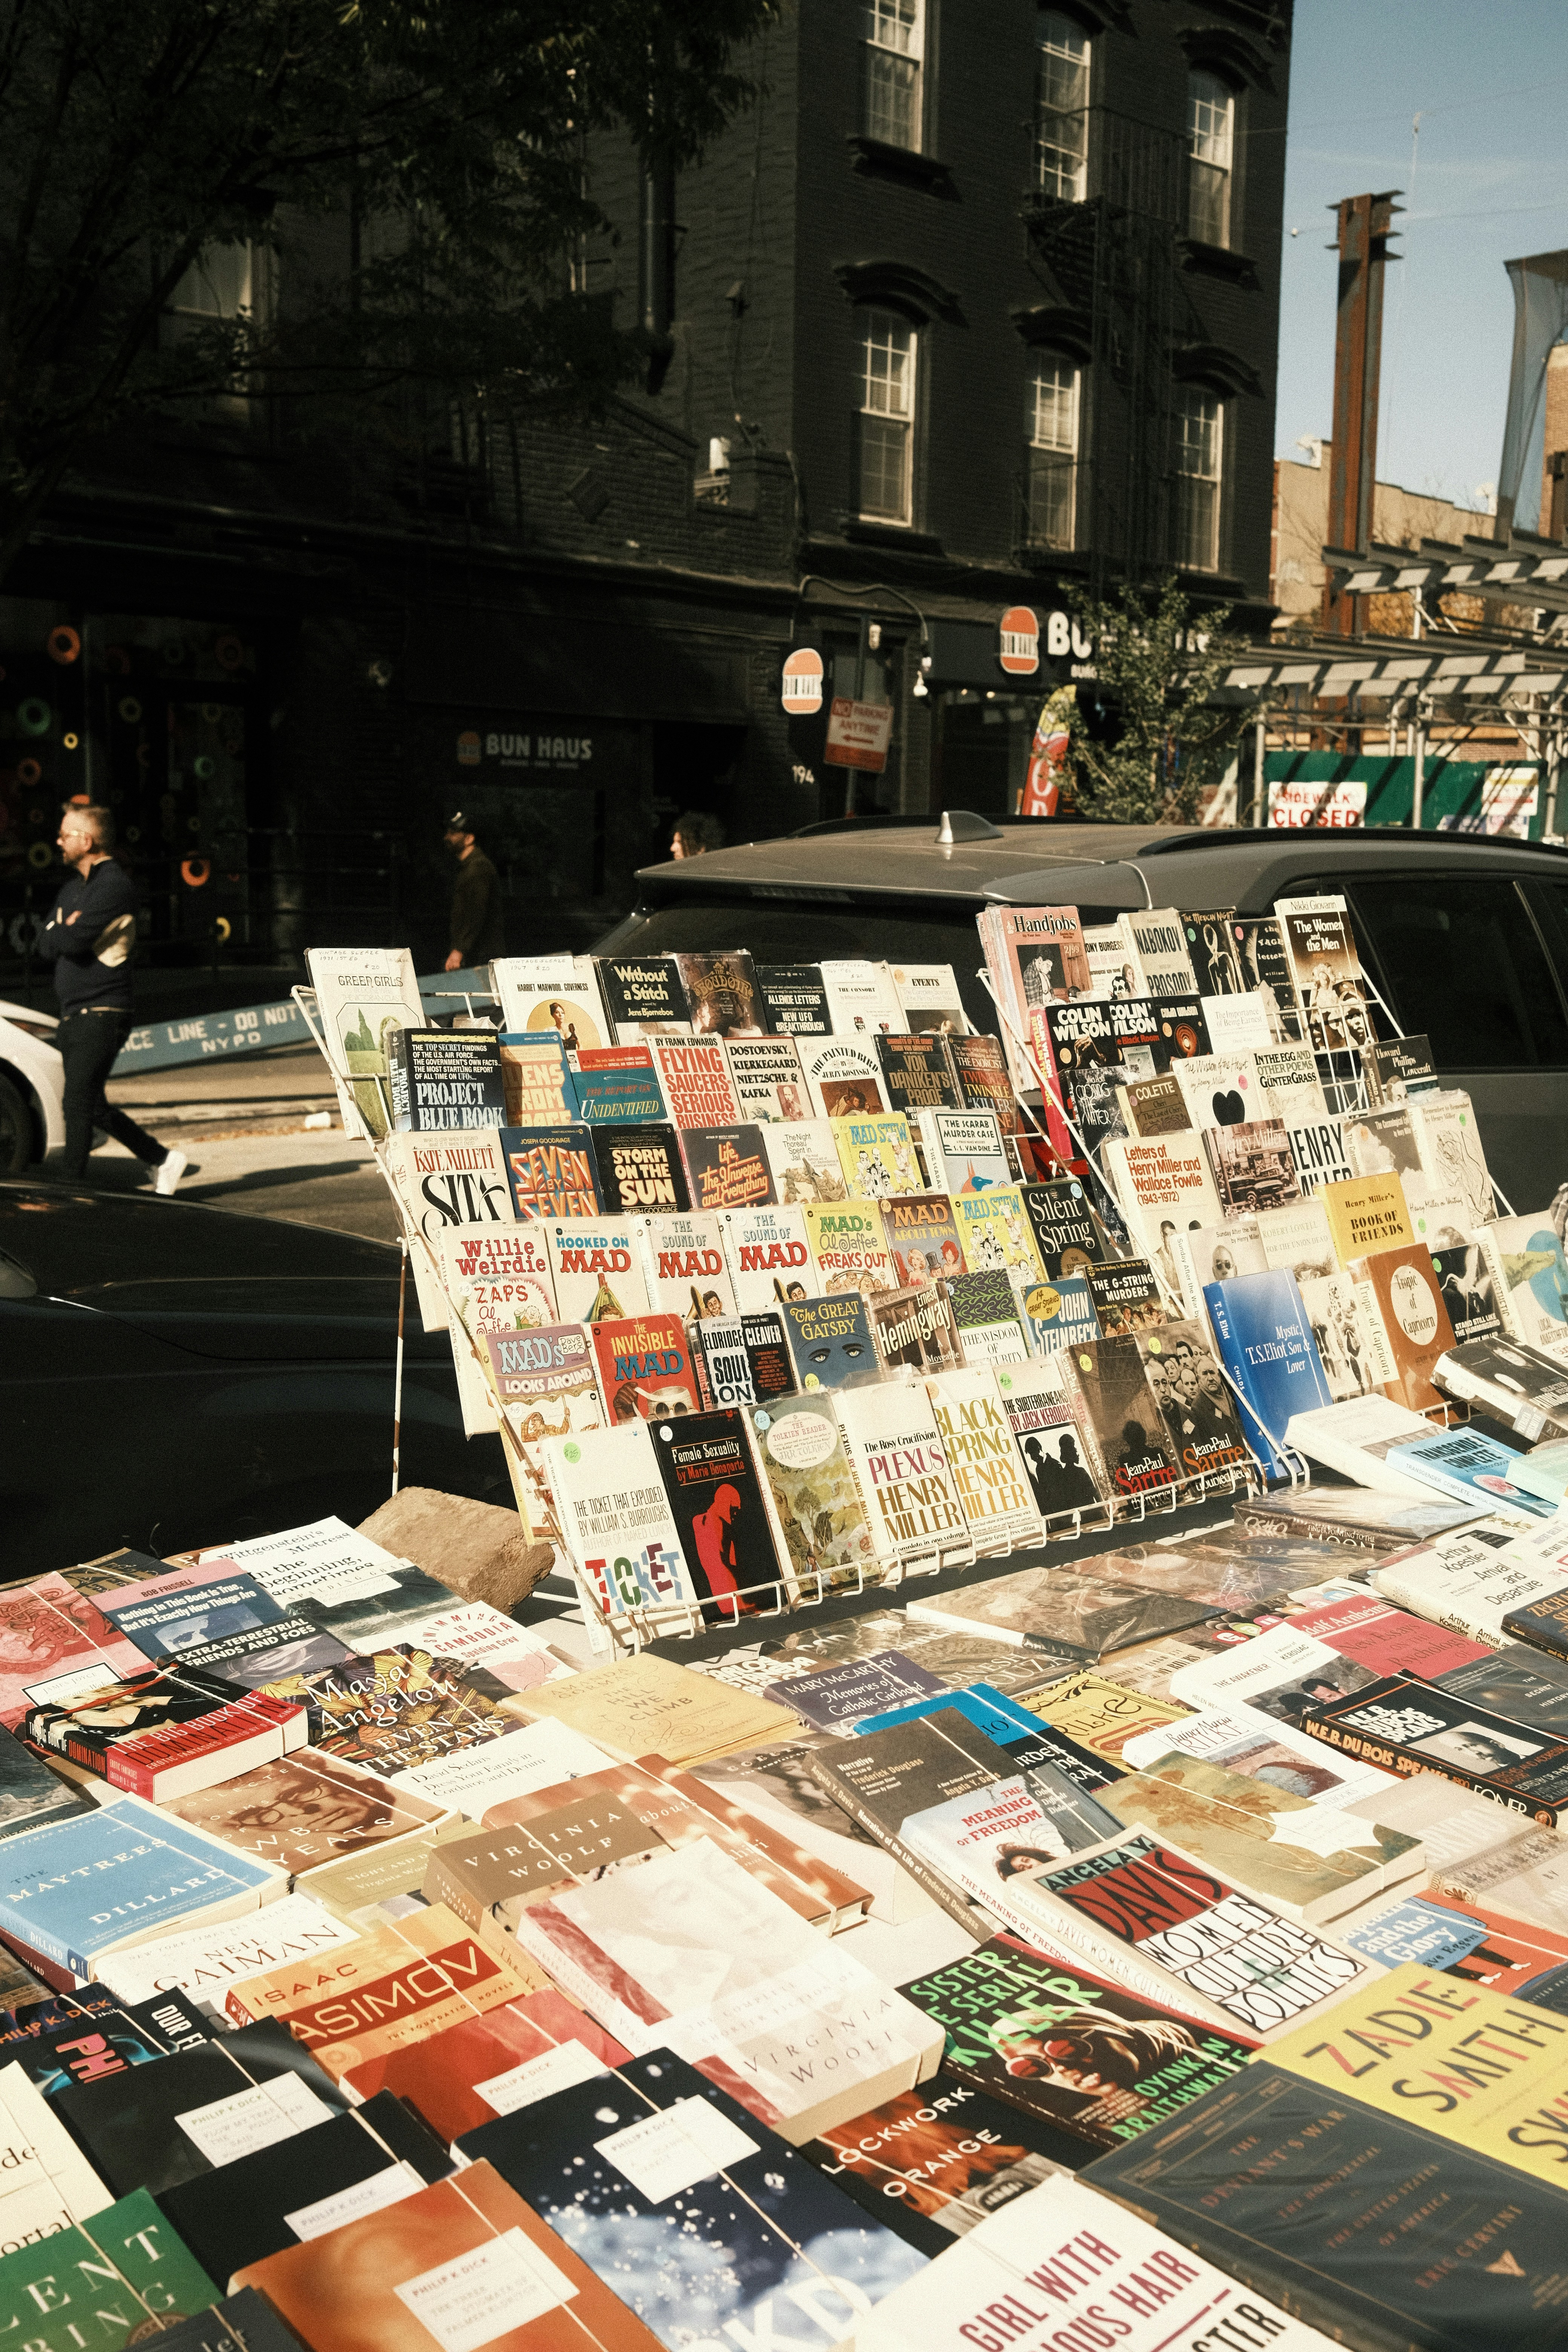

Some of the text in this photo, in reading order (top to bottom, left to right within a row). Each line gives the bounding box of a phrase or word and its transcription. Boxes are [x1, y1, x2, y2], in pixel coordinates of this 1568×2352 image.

[486, 734, 592, 760] BUN HAUS
[792, 765, 814, 784] 194
[1272, 808, 1360, 828] CLOSED
[1013, 914, 1077, 936] Handjobs
[1294, 919, 1344, 933] The Women
[1133, 926, 1183, 956] NABOKOV
[1306, 939, 1340, 952] the Men
[374, 977, 403, 986] GIRLS
[614, 966, 667, 984] Without
[624, 986, 668, 1001] a Stitch
[167, 1005, 302, 1040] LINE DO NOT
[1058, 1007, 1102, 1024] COLIN
[202, 1031, 262, 1052] NYPD
[1053, 1021, 1111, 1041] WILSON
[663, 1049, 723, 1073] FLYING
[730, 1045, 791, 1056] DOSTOEVSKY,
[734, 1060, 800, 1070] KIERKEGAARD,
[737, 1074, 787, 1084] NIETZSCHE
[1259, 1071, 1316, 1088] GÜNTER GRASS
[416, 1083, 484, 1106] PROJECT
[741, 1088, 771, 1098] KAFKA
[1136, 1082, 1175, 1100] COLETTE
[582, 1099, 658, 1118] UNIDENTIFIED
[671, 1093, 733, 1114] SERIOUS
[419, 1107, 504, 1130] BLUE BOOK
[945, 1120, 989, 1129] THE SCARAB
[943, 1130, 975, 1139] MURDER
[415, 1147, 495, 1173] KATE MILLETT
[612, 1148, 668, 1164] STORM
[615, 1164, 670, 1179] ON THE
[619, 1179, 676, 1205] SUN
[1032, 1191, 1082, 1221] Silent
[820, 1217, 873, 1232] MAD's
[1351, 1210, 1398, 1229] BOOK OF
[557, 1237, 629, 1248] HOOKED ON
[1040, 1222, 1095, 1255] Spring
[1352, 1223, 1404, 1243] FRIENDS
[461, 1238, 534, 1257] Willie
[456, 1256, 546, 1275] Weirdie
[560, 1250, 631, 1273] MAD
[818, 1253, 888, 1271] FREAKS OUT
[1092, 1274, 1154, 1291] THE G-STRING
[1395, 1272, 1418, 1291] Tropic
[474, 1285, 528, 1304] ZAPS
[1107, 1287, 1149, 1302] MURDERS
[1409, 1294, 1418, 1309] of
[790, 1302, 859, 1323] The GREAT
[634, 1324, 647, 1333] THE
[746, 1325, 782, 1346] CLEAVER
[801, 1321, 856, 1340] GATSBY
[878, 1299, 952, 1357] Hemingway
[1403, 1317, 1435, 1336] Capricorn
[611, 1331, 675, 1354] INVISIBLE
[704, 1331, 743, 1350] ELDRIDGE
[1289, 1342, 1302, 1355] Son
[615, 1351, 684, 1380] MAD
[715, 1356, 749, 1381] SOUL
[1287, 1359, 1306, 1374] Lover
[672, 1442, 740, 1462] Female Sexuality
[868, 1445, 945, 1485] PLEXUS
[574, 1486, 664, 1517] THE TICKET THAT EXPLODED
[876, 1473, 949, 1516] HENRY
[884, 1502, 961, 1543] MILLER
[1438, 1545, 1473, 1563] Arthur
[1441, 1551, 1489, 1576] Koestler
[142, 1579, 194, 1598] BOB FRISSELL
[1484, 1579, 1544, 1606] Departure
[175, 1618, 309, 1663] EXTRA-TERRESTRIAL
[184, 1625, 316, 1668] FRIENDS AND FOES
[302, 1665, 410, 1707] Maya
[786, 1677, 825, 1695] MARY
[318, 1679, 458, 1740] Angelou
[110, 1692, 262, 1754] THE BIG BOOK OF
[125, 1700, 288, 1766] DOMINATION
[1000, 1786, 1023, 1798] THE
[962, 1796, 1034, 1827] MEANING
[957, 1810, 1043, 1846] OF FREEDOM
[464, 1812, 622, 1867] VIRGINIA
[6, 1838, 167, 1902] MAYTREES
[1044, 1851, 1133, 1891] ANGELA
[90, 1868, 226, 1924] DILLARD
[1061, 1850, 1220, 1938] DAVIS
[1136, 1897, 1272, 1969] WOMEN
[153, 1925, 340, 1993] GAIMAN
[204, 1937, 268, 1960] NEIL
[254, 1963, 357, 2005] ISAAC
[290, 1946, 478, 2042] ASIMOV
[960, 1962, 1049, 2014] SERIAL
[949, 1976, 1103, 2067] KILLER
[1304, 1980, 1479, 2076] ZADIE
[1393, 2009, 1567, 2112] SMITH
[883, 2128, 1001, 2197] ORANGE
[959, 2230, 1121, 2352] GIRL WITH
[1110, 2250, 1199, 2318] HAIR
